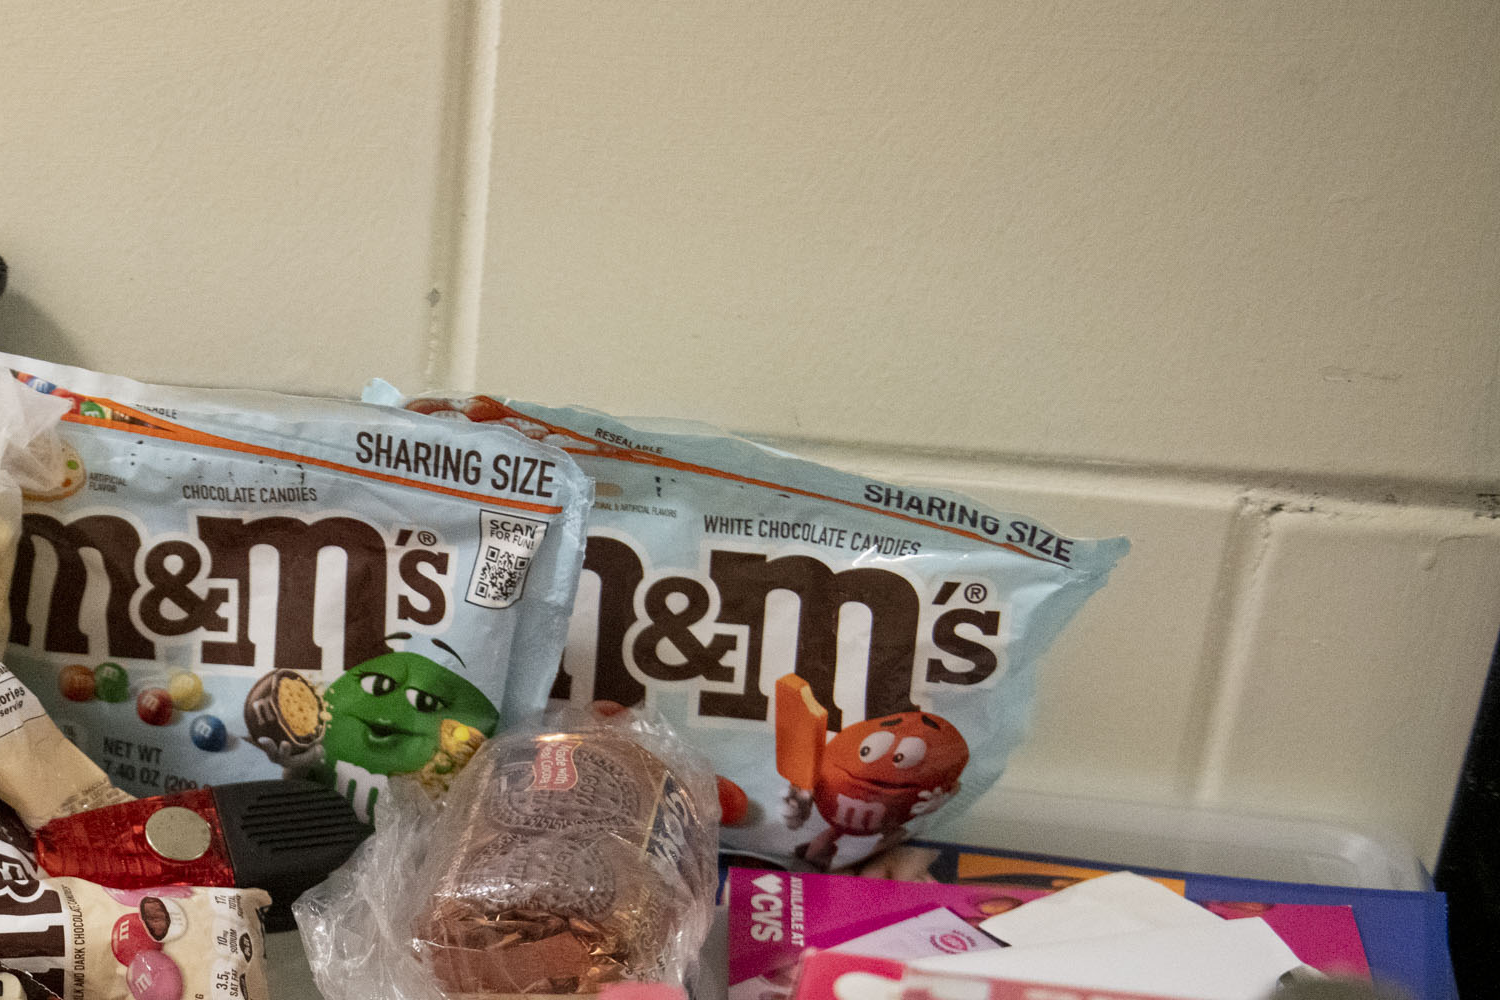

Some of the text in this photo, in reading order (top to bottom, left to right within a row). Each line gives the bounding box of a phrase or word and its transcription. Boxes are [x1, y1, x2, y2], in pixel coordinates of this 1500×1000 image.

[355, 431, 557, 498] SHARING SIZE
[182, 484, 318, 503] CHOCOLATE CANDIES
[490, 519, 536, 539] SCAN
[704, 514, 922, 556] WHITE CHOCOLATE CANDIES
[864, 484, 1074, 562] SHARING SIZE
[490, 530, 535, 550] FOR FUN!
[103, 737, 163, 765] NET WT
[139, 769, 161, 789] OZ
[750, 894, 784, 942] CVS
[790, 876, 805, 947] AVAILABLE AT
[73, 947, 86, 971] DARK
[73, 973, 85, 989] AND
[229, 969, 240, 998] SAT FAT
